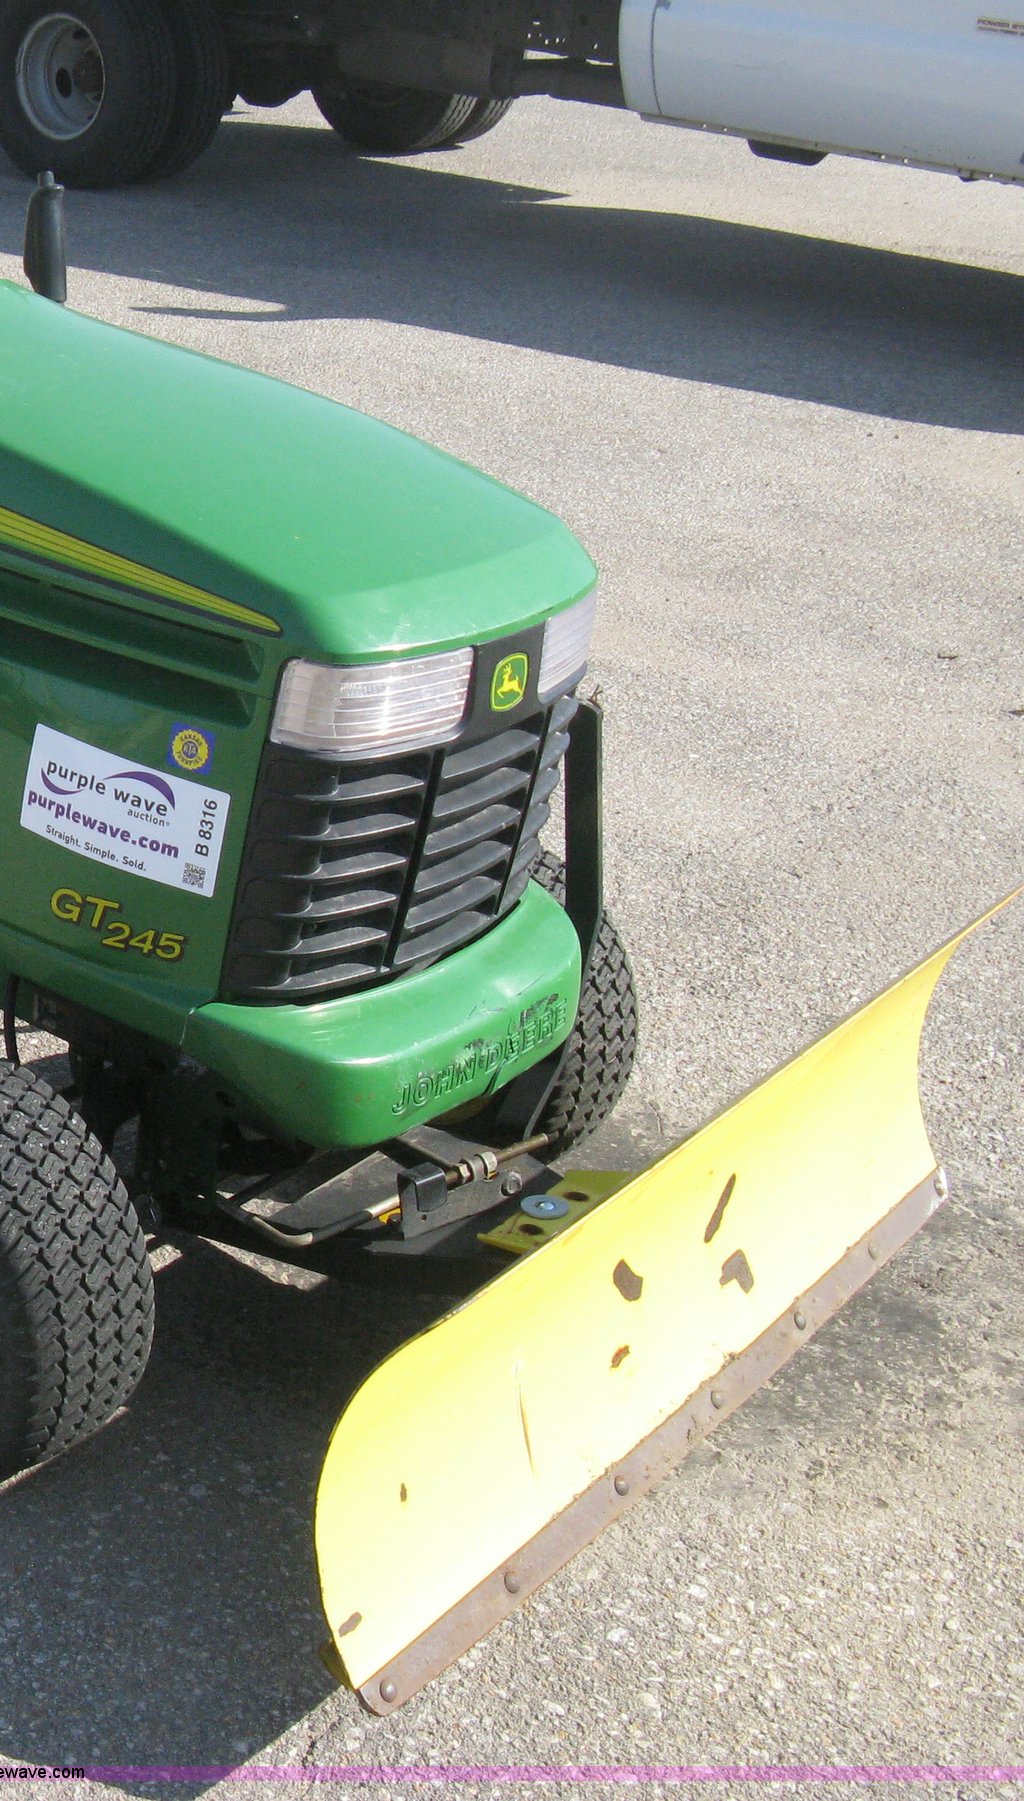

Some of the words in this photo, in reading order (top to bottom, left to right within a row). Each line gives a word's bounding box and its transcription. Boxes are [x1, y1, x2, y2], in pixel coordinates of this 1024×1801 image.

[46, 760, 106, 795] purple
[113, 786, 168, 817] wave
[27, 790, 180, 859] purplewave.com
[127, 808, 166, 828] auction
[197, 798, 218, 841] 8316
[45, 824, 82, 848] Straight.
[84, 841, 119, 863] Simple.
[122, 855, 147, 872] Sold.
[194, 843, 209, 857] B
[50, 888, 121, 929] GT
[101, 921, 186, 961] 245
[391, 1052, 477, 1116] JOHN
[485, 1001, 568, 1075] DEERE
